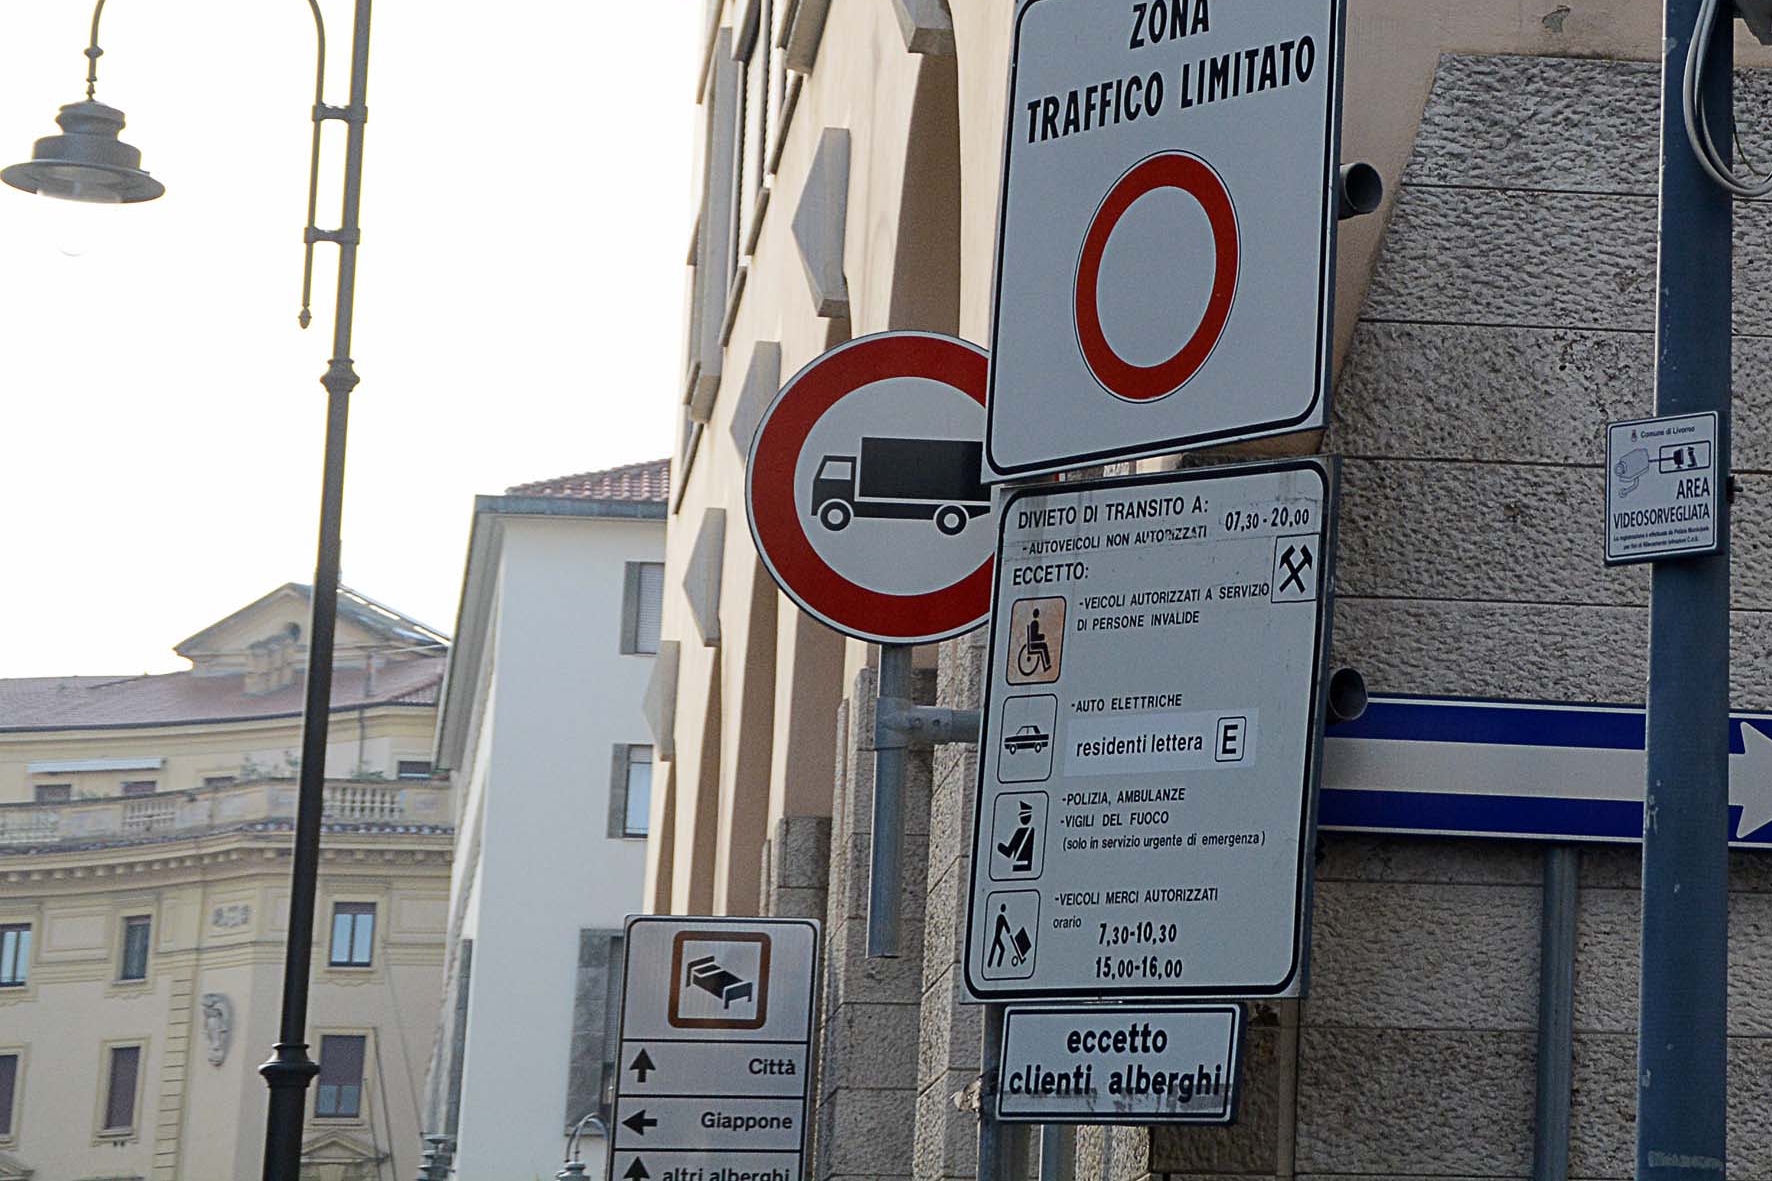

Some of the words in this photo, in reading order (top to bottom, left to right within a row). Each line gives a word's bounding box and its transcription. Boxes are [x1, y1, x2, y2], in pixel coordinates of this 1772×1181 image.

[1027, 71, 1164, 144] TRAFFICO
[1180, 35, 1316, 109] LIMITATO
[1676, 477, 1710, 499] AREA
[1018, 506, 1077, 530] DIVIETO
[1083, 504, 1099, 524] DI
[1106, 496, 1185, 522] TRANSITO
[1191, 495, 1209, 514] A:
[1613, 503, 1710, 529] VIDEOSORVEGLIATA
[1022, 536, 1101, 556] -AUTOVEICOLI
[1106, 532, 1130, 548] NON
[1134, 524, 1208, 545] AUTORIZZATI
[1013, 561, 1089, 587] ECCETTO:
[1079, 594, 1126, 610] -VEICOLI
[1130, 588, 1201, 607] AUTORIZZATI
[1205, 587, 1213, 601] A
[1218, 582, 1271, 600] SERVIZIO
[1077, 619, 1088, 632] DI
[1092, 615, 1145, 631] PERSONE
[1151, 610, 1200, 627] INVALIDE
[1071, 698, 1105, 713] -AUTO
[1111, 693, 1183, 711] ELETTRICHE
[1076, 734, 1147, 757] residenti
[1151, 733, 1204, 753] lettera
[1222, 725, 1238, 754] E
[1117, 787, 1186, 803] AMBULANZE
[1060, 815, 1095, 828] -VIGILI
[1102, 813, 1123, 827] DEL
[1129, 810, 1170, 825] FUOCO
[1062, 836, 1087, 852] (solo
[1090, 835, 1099, 850] in
[1101, 834, 1140, 849] servizio
[1143, 834, 1183, 850] urgente
[1186, 832, 1197, 846] di
[1054, 892, 1100, 906] -VEICOLI
[1105, 890, 1139, 904] MERCI
[1144, 887, 1218, 903] AUTORIZZATI
[1052, 915, 1082, 929] orario
[1066, 1023, 1168, 1053] eccetto
[748, 1058, 796, 1075] Città
[1009, 1064, 1092, 1095] clienti
[1108, 1064, 1222, 1103] alberghi
[700, 1111, 793, 1130] Giappone
[662, 1168, 703, 1181] altri
[709, 1168, 790, 1181] alberghi
